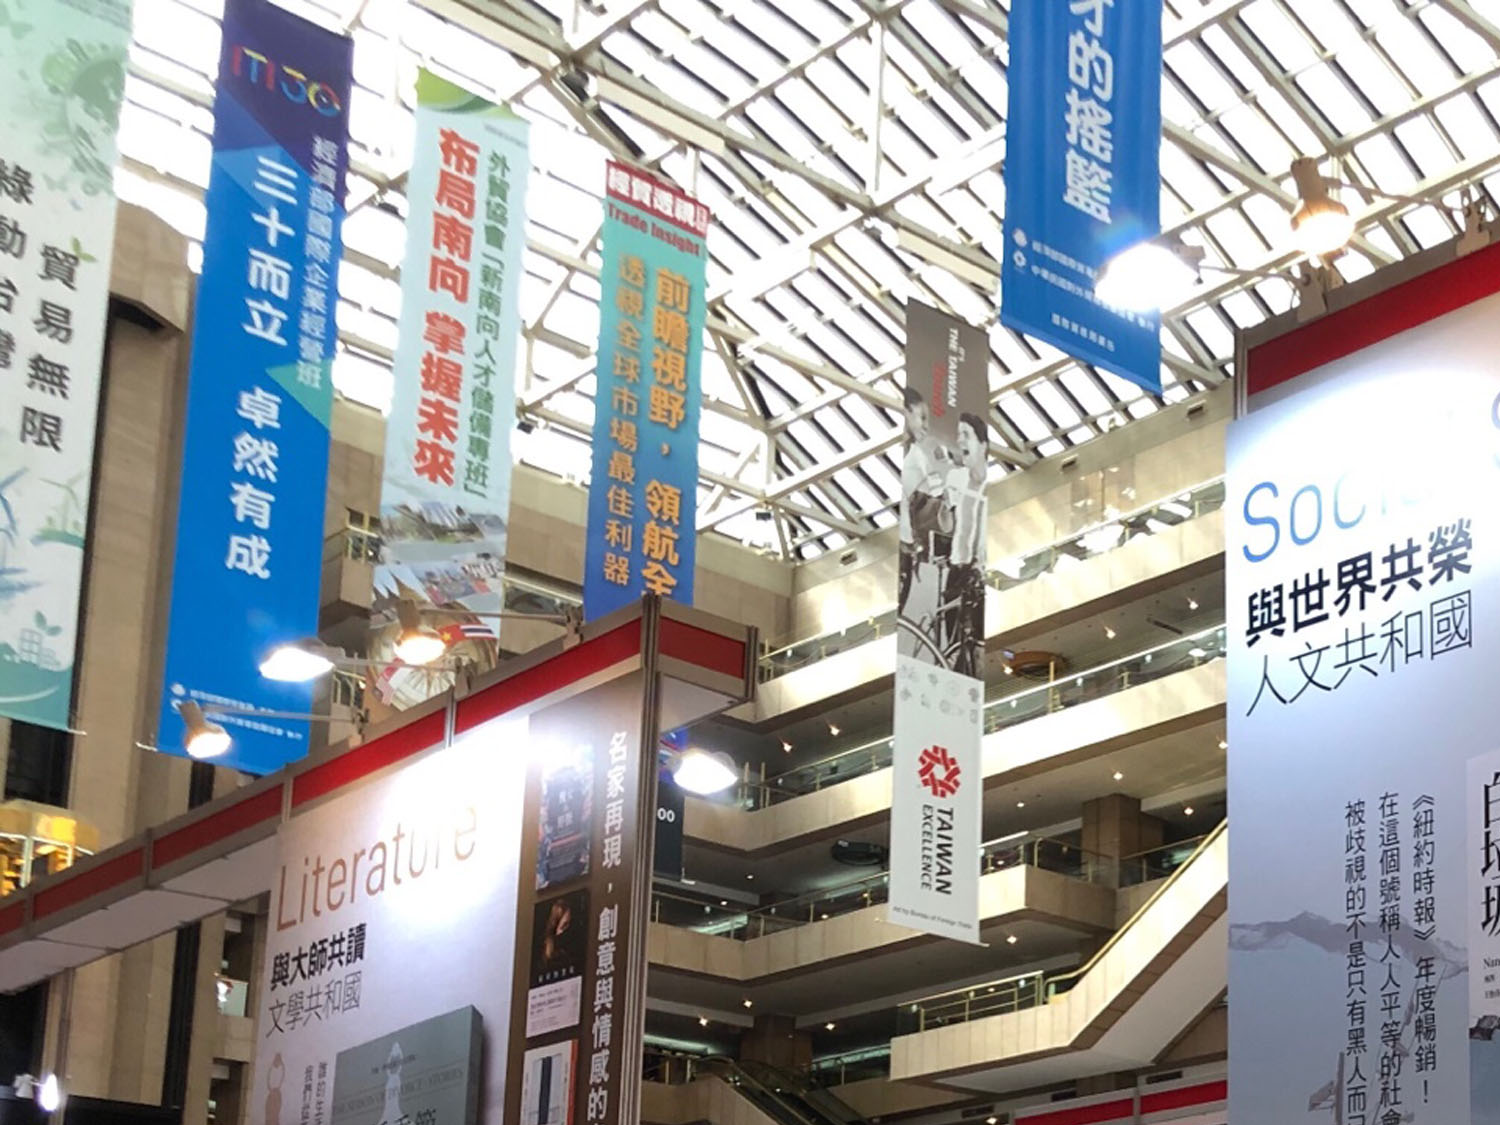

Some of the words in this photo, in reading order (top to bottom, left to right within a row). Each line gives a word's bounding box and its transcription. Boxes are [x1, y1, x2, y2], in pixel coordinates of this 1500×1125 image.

[243, 155, 299, 347] 三十而立
[428, 126, 481, 304] 布局南向
[19, 243, 80, 453] 貿易無限
[413, 309, 467, 488] 掌握未來
[603, 252, 647, 587] 透視全球市場最佳利器
[224, 386, 283, 582] 卓然有成
[1245, 519, 1474, 649] 與世界共榮
[1245, 590, 1474, 718] 人文共和國
[920, 803, 934, 892] EXCELLENCE
[935, 807, 954, 896] TAIWAN
[265, 970, 363, 1038] 文學共和國
[269, 922, 367, 991] 與大師共讀
